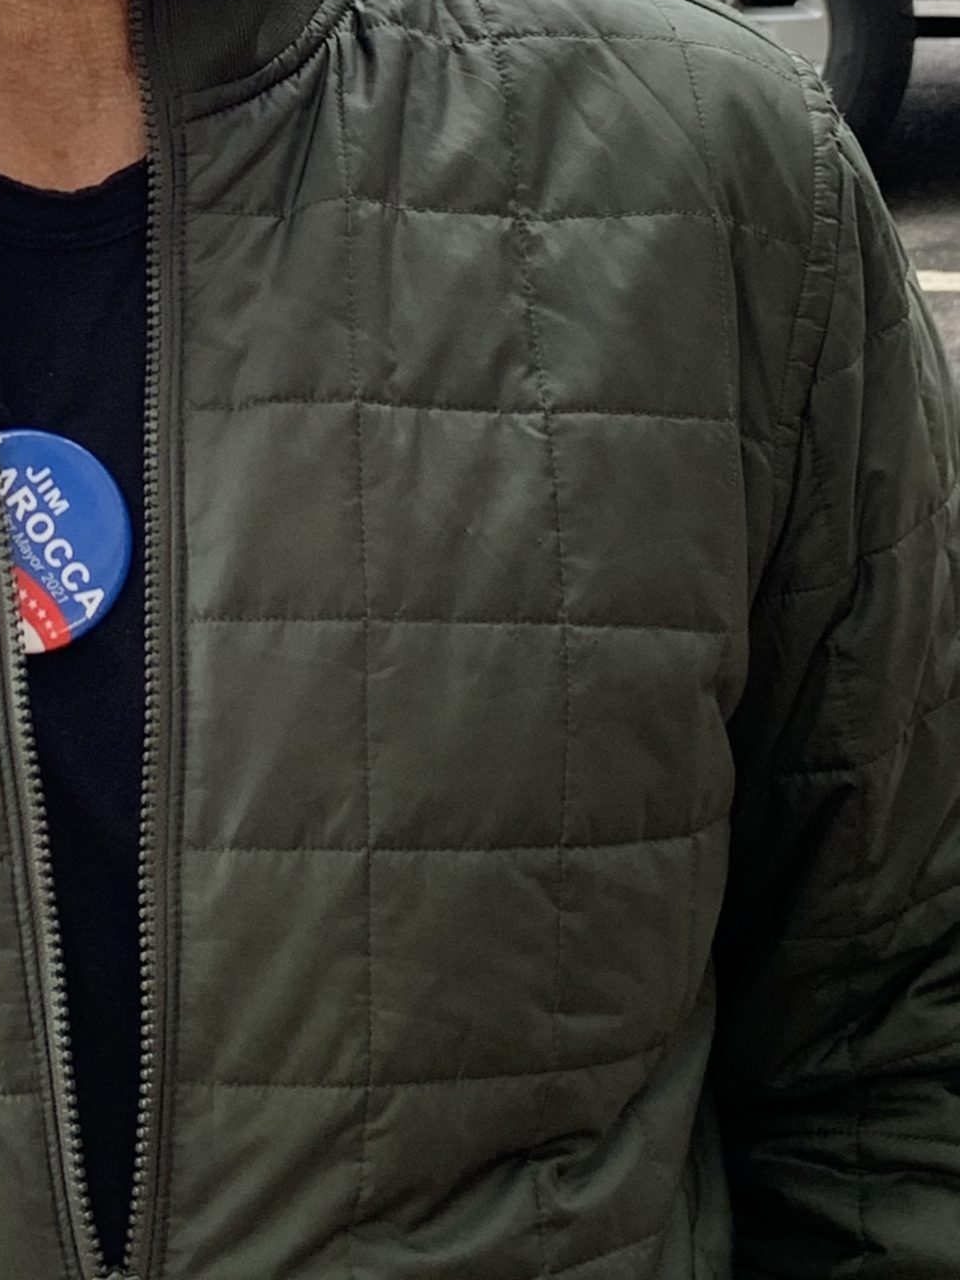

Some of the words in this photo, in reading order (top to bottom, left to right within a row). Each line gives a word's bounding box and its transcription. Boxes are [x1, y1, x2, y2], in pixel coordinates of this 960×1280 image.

[26, 466, 70, 516] JIM
[12, 532, 45, 571] Mayor
[41, 572, 69, 604] 2021
